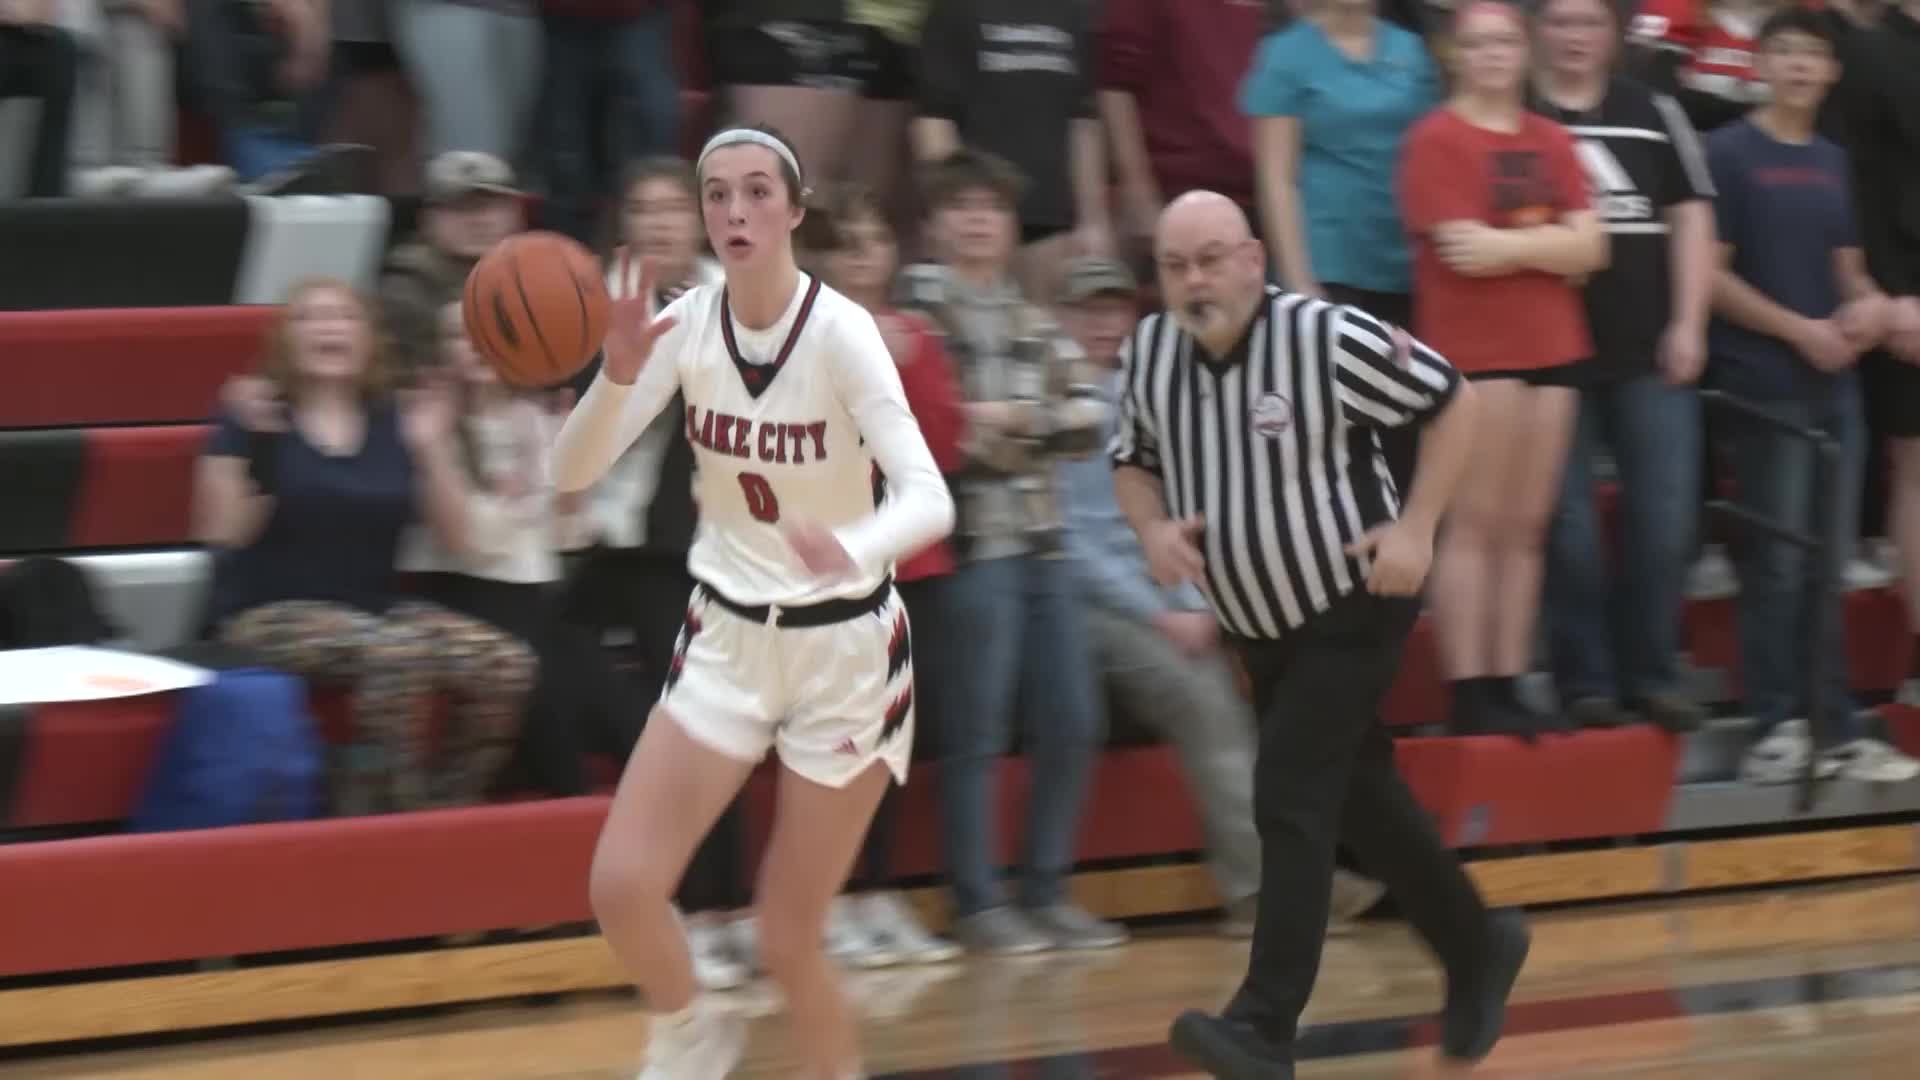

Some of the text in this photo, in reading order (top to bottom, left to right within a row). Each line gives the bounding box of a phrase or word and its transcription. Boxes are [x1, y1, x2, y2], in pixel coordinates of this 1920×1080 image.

[687, 405, 827, 464] LAKE CITY
[737, 472, 780, 524] 0
